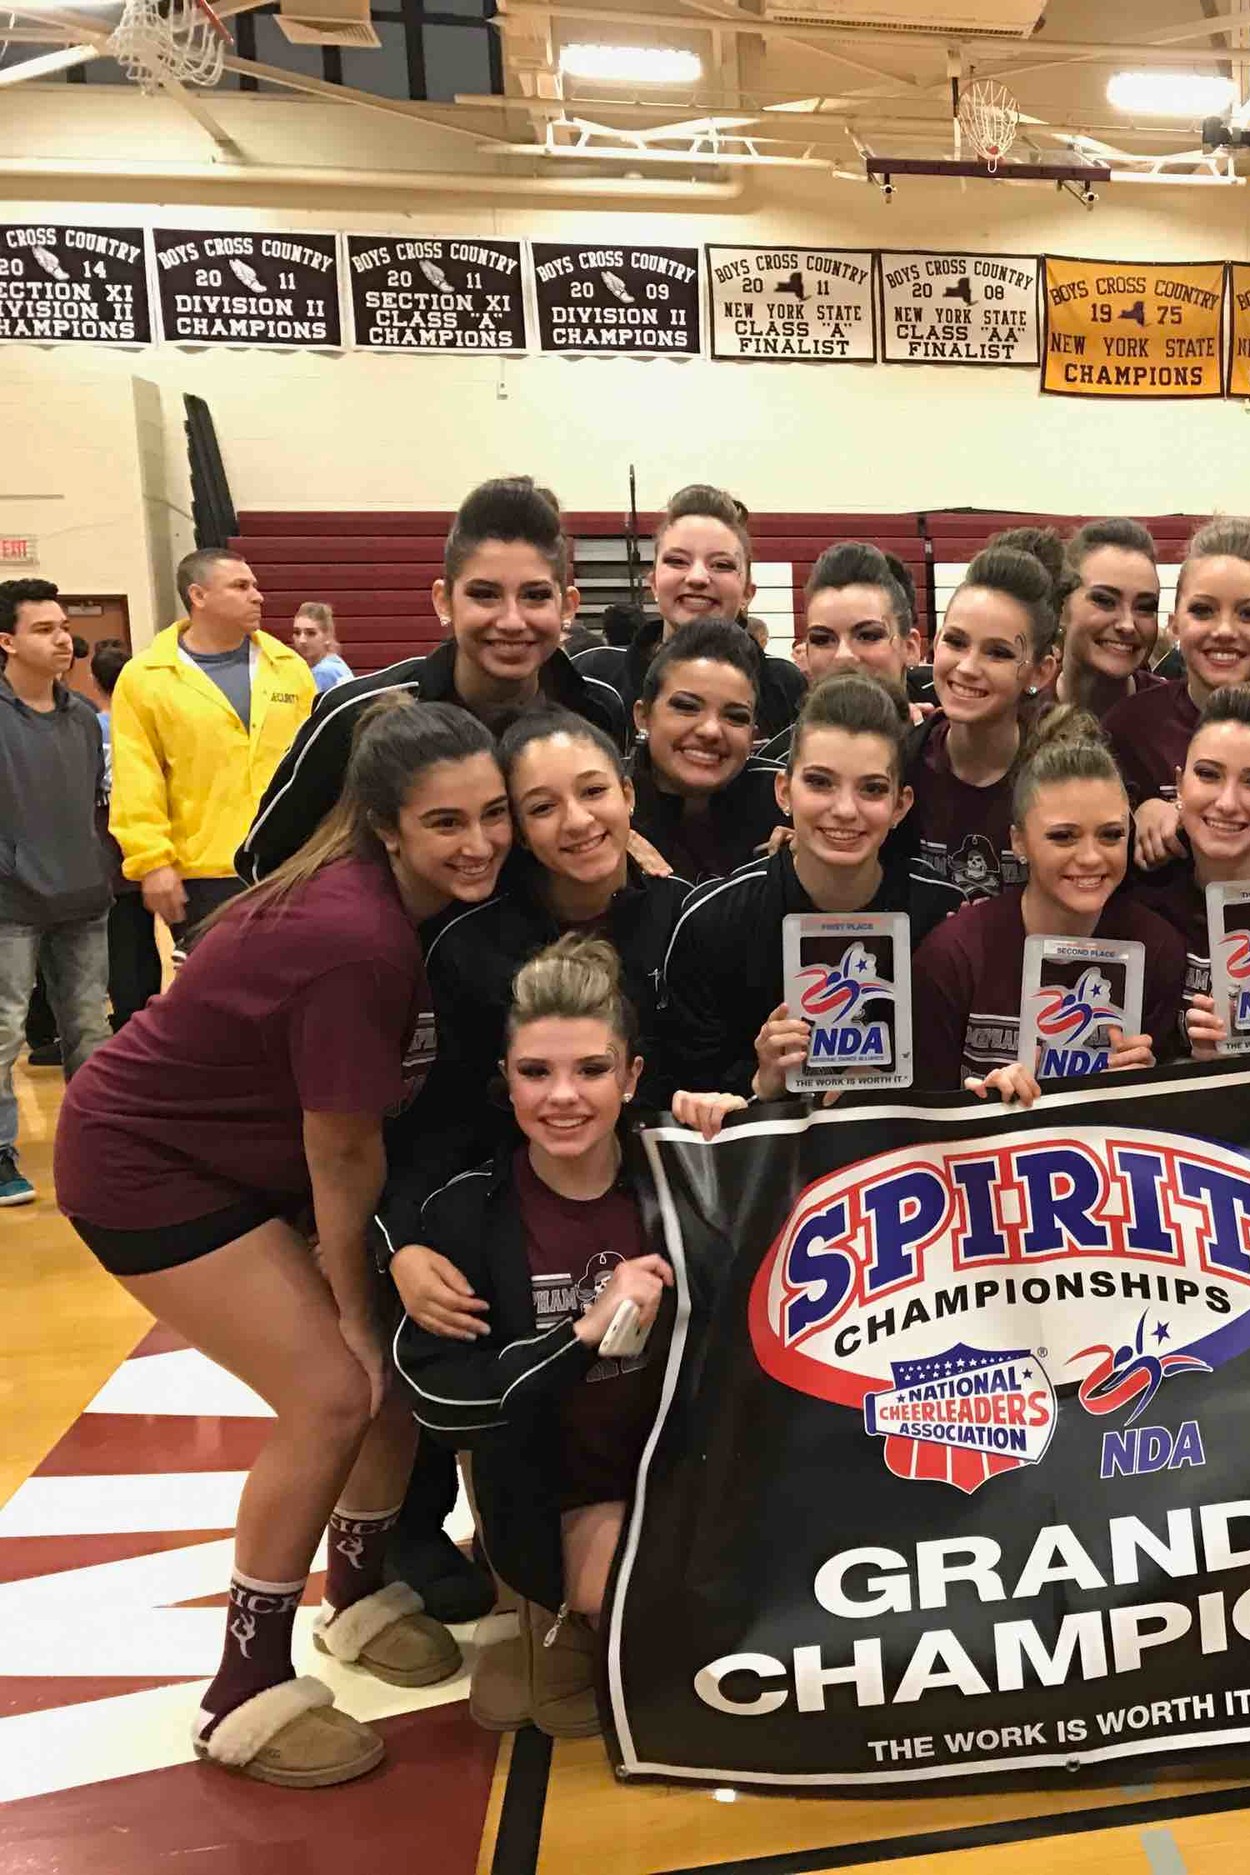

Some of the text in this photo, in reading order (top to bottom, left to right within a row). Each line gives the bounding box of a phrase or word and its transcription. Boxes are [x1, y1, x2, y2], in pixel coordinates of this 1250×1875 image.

[6, 228, 140, 263] CROSS COUNTRY
[158, 237, 333, 273] BOYS CROSS COUNTRY
[83, 260, 107, 278] 14
[352, 242, 518, 276] BOYS CROSS COUNTRY
[536, 250, 696, 284] BOYS CROSS COUNTRY
[195, 269, 297, 290] 20 11
[387, 270, 482, 290] 20 11
[714, 254, 869, 286] BOYS CROSS COUNTRY
[885, 259, 1034, 290] BOYS CROSS COUNTRY
[106, 285, 134, 302] XI
[570, 282, 670, 300] 20 09
[742, 278, 830, 296] 20 11
[912, 283, 1005, 300] 20 08
[1049, 277, 1220, 311] BOYS CROSS COUNTRY
[113, 303, 132, 320] II
[175, 294, 325, 317] DIVISION II
[365, 292, 511, 311] SECTION XI
[724, 301, 862, 321] NEW YORK STATE
[375, 310, 458, 328] CLASS
[552, 306, 686, 326] DIVISION II
[894, 307, 1027, 326] NEW YORK STATE
[1090, 303, 1183, 325] 19 75
[177, 316, 327, 339] CHAMPIONS
[369, 328, 513, 346] CHAMPIONS
[552, 328, 688, 347] CHAMPIONS
[734, 320, 810, 338] CLASS
[896, 324, 968, 341] CLASS
[739, 338, 850, 356] FINALIST
[908, 341, 1015, 359] FINALIST
[1050, 332, 1215, 358] NEW YORK STATE
[1065, 363, 1203, 386] CHAMPIONS
[1056, 947, 1089, 956] SECOND
[812, 1027, 884, 1056] NDA
[1043, 1048, 1109, 1077] NDA
[834, 1270, 1232, 1358] CHAMPIONSHIPS
[909, 1366, 1021, 1402] NATIONAL
[879, 1391, 1049, 1427] CHEERLEADERS
[900, 1422, 1027, 1451] ASSOCIATION
[1101, 1420, 1205, 1479] NDA
[868, 1736, 935, 1762] THE
[944, 1722, 1047, 1754] WORK
[1057, 1719, 1088, 1742] IS
[1095, 1694, 1215, 1736] WORTH
